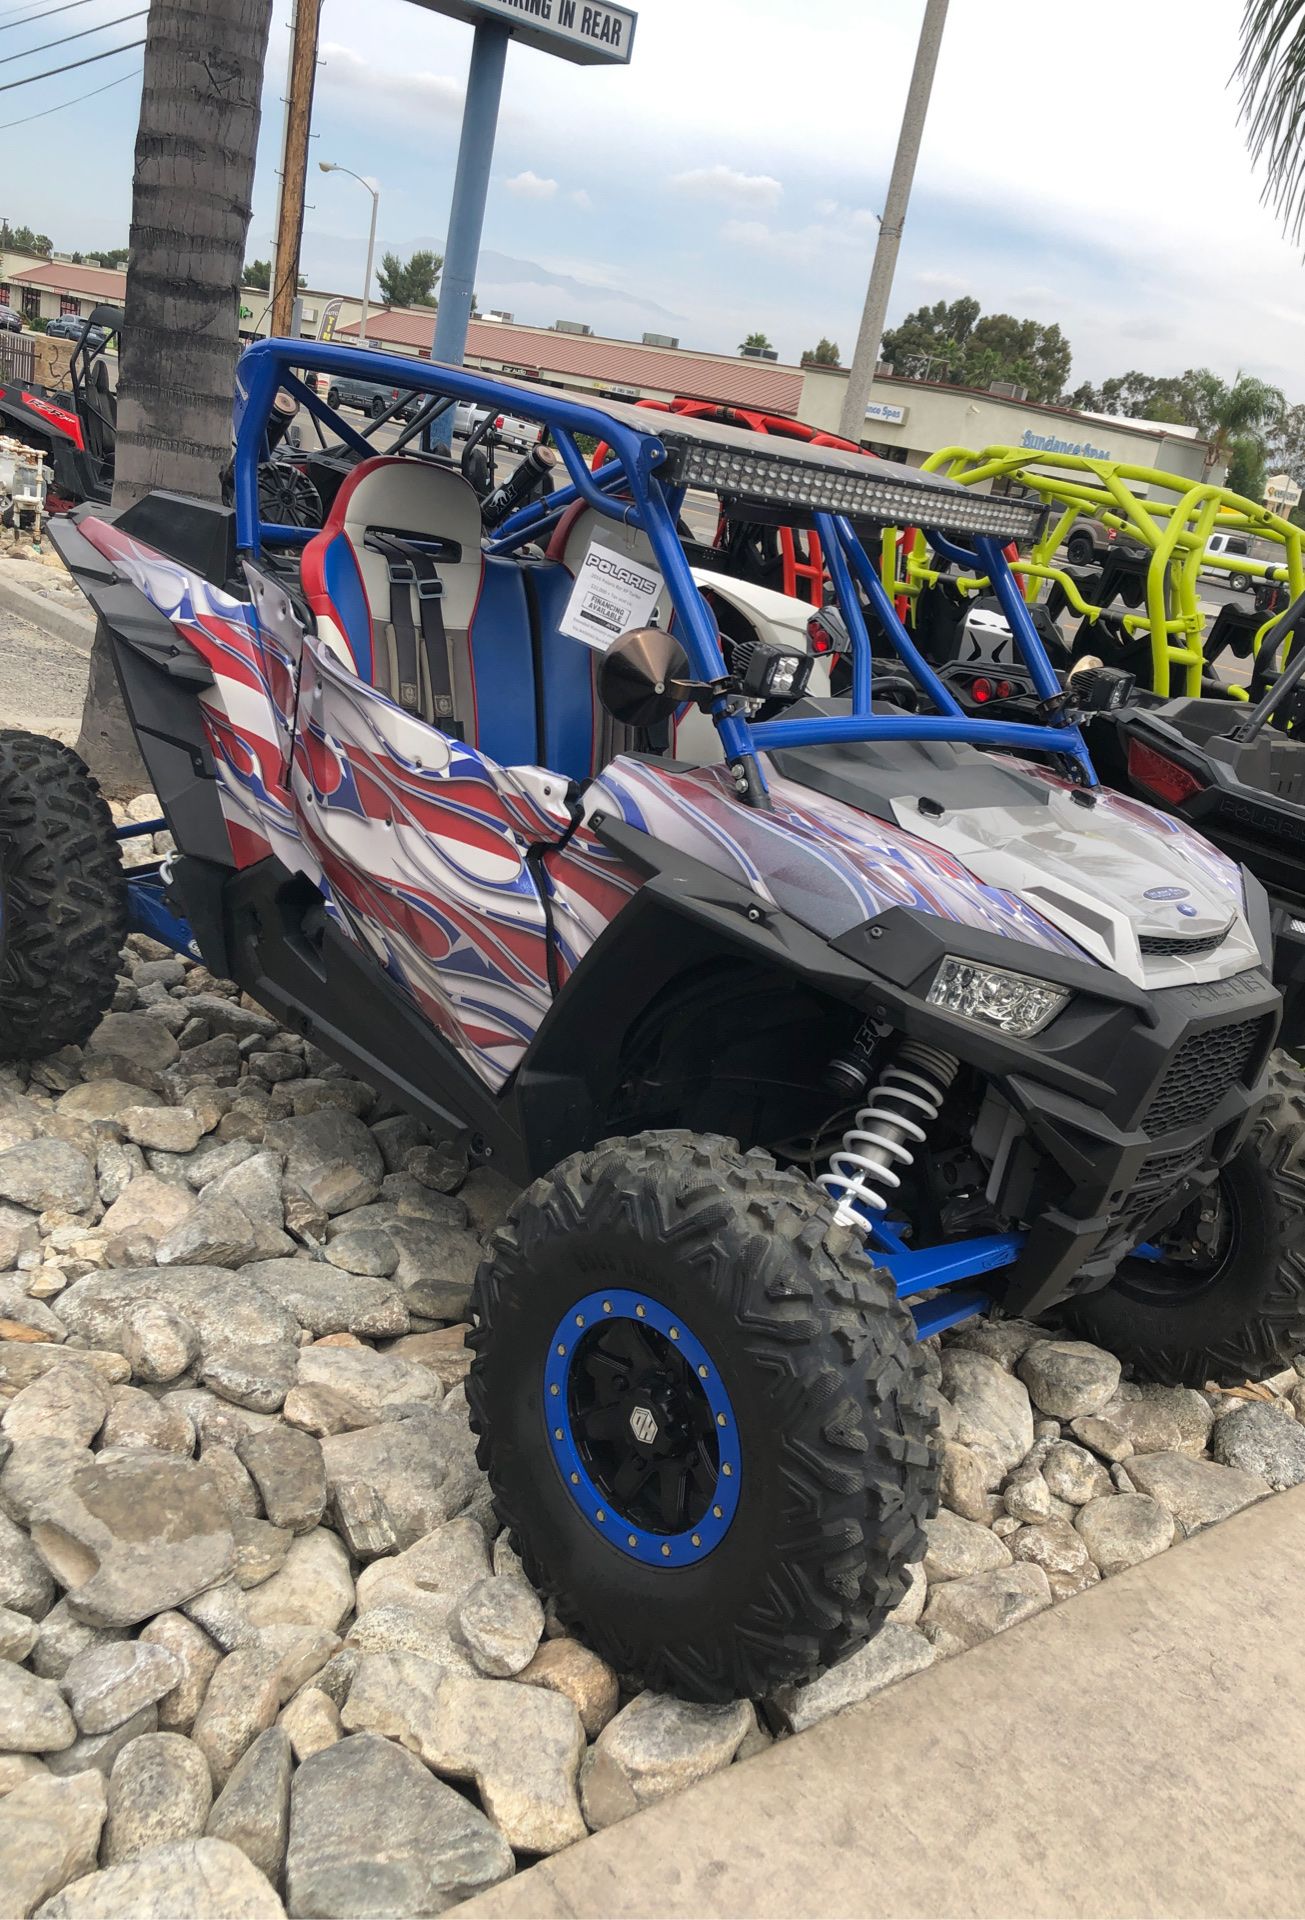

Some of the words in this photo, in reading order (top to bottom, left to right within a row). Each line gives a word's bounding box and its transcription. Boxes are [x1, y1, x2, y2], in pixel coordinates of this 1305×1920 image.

[558, 0, 577, 29] IN
[580, 6, 623, 47] REAR
[586, 553, 657, 596] POLARIS
[588, 602, 622, 622] AVAILABLE
[590, 595, 625, 616] FINANCING
[1217, 799, 1305, 842] POLARI
